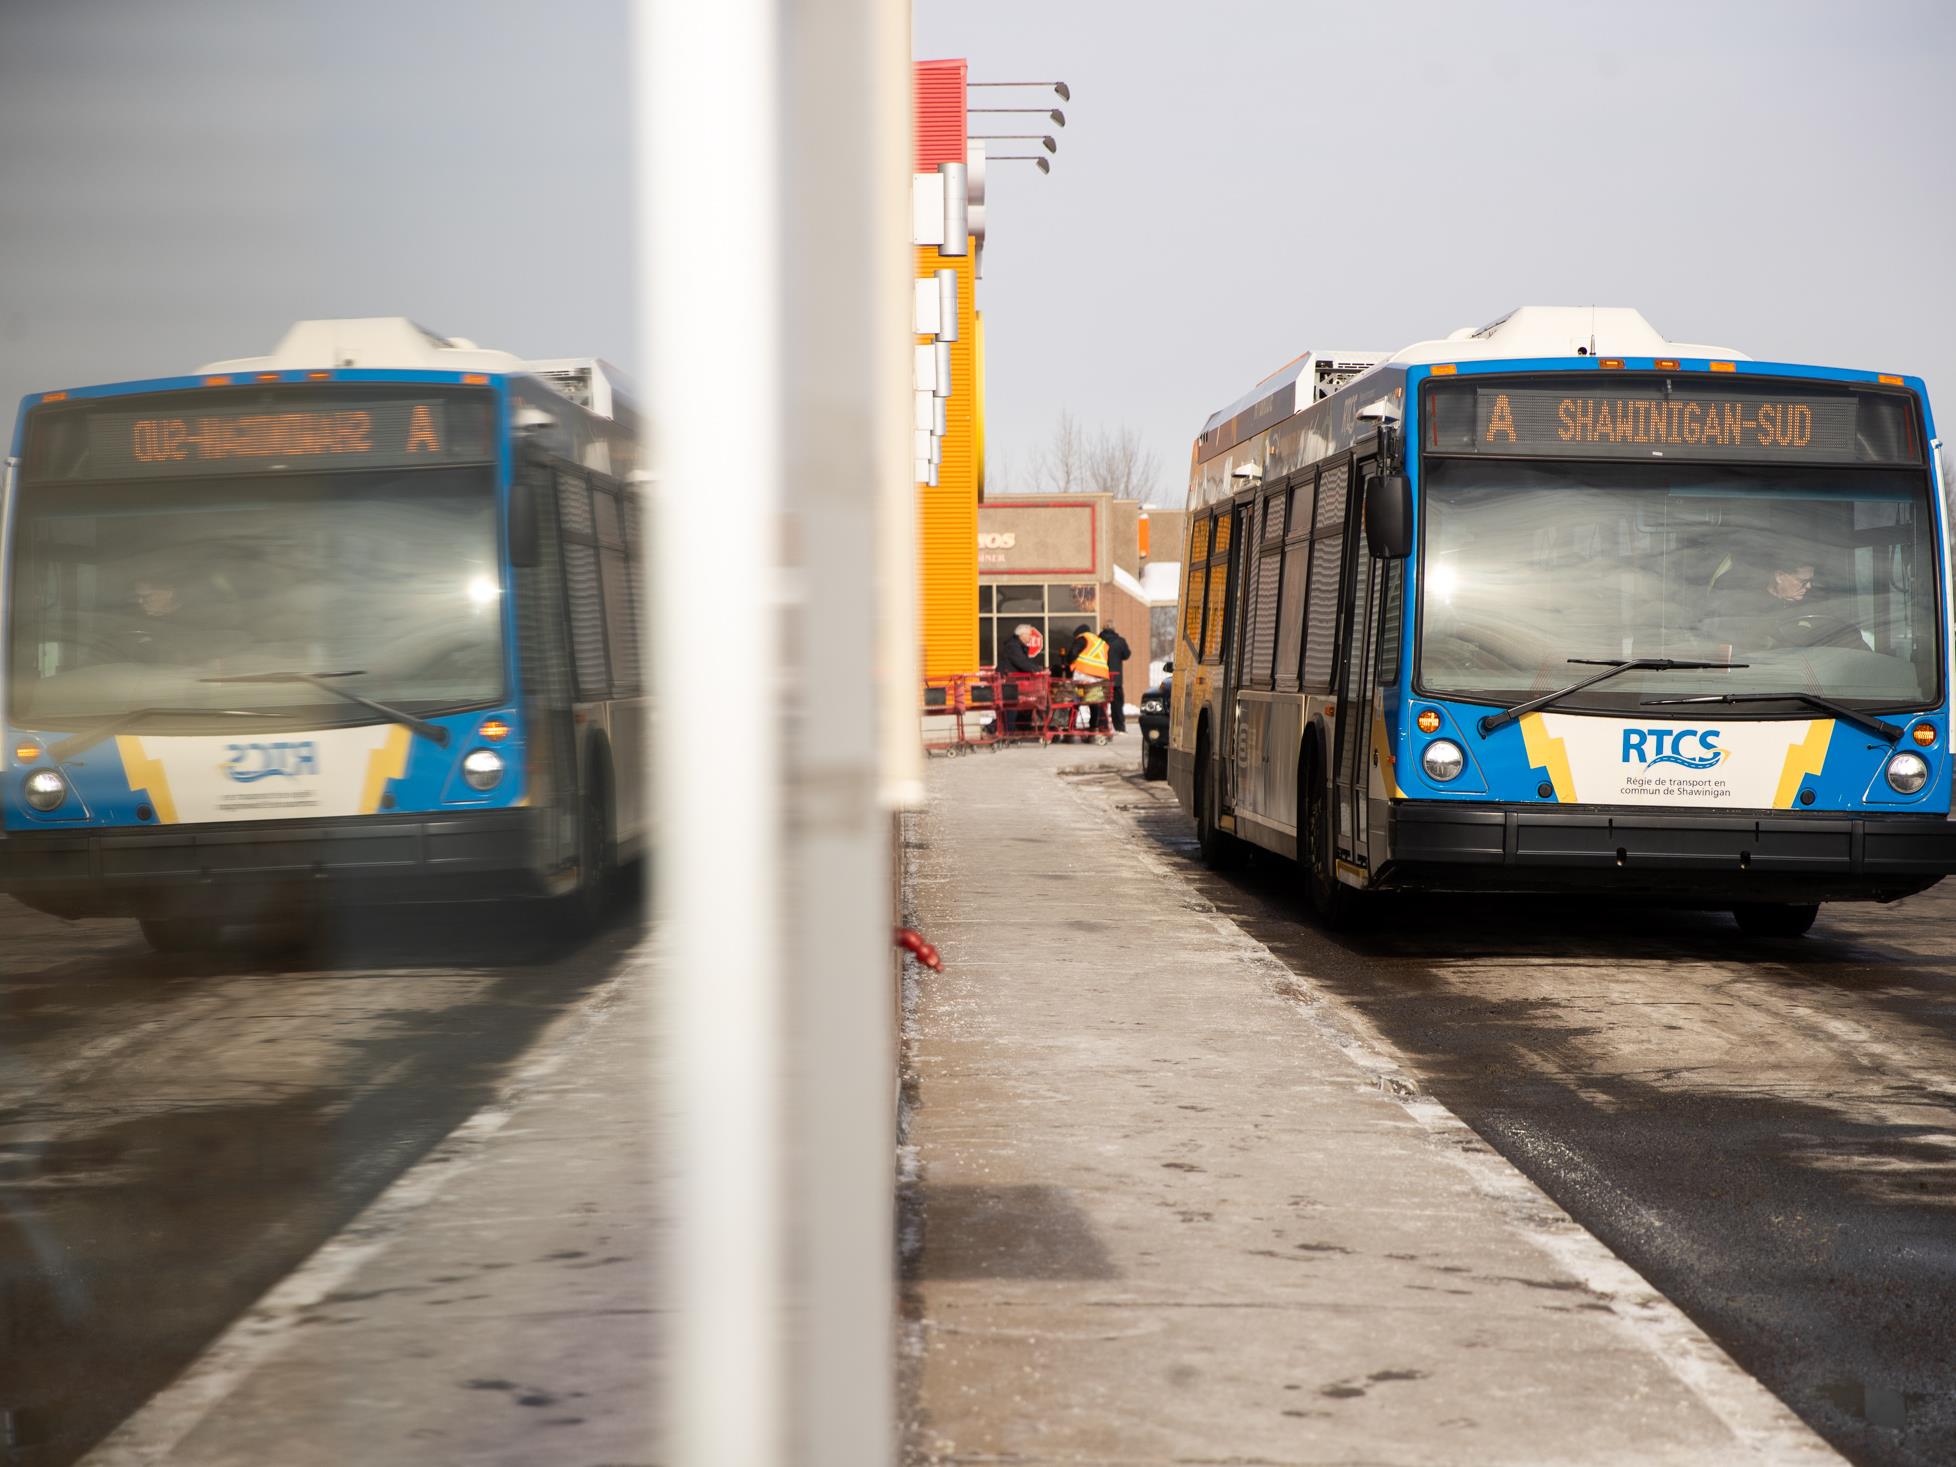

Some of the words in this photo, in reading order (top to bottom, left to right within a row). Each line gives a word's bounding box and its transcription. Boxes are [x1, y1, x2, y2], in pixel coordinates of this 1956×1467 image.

[1486, 394, 1517, 443] A
[1557, 399, 1812, 447] SHAWINIGAN-SUD
[1621, 728, 1721, 765] RTCS
[1620, 787, 1661, 795] commun
[1663, 787, 1675, 796] de
[1677, 787, 1731, 799] Shawinigan
[1626, 776, 1652, 787] Régie
[1654, 777, 1667, 786] de
[1669, 778, 1711, 788] transport
